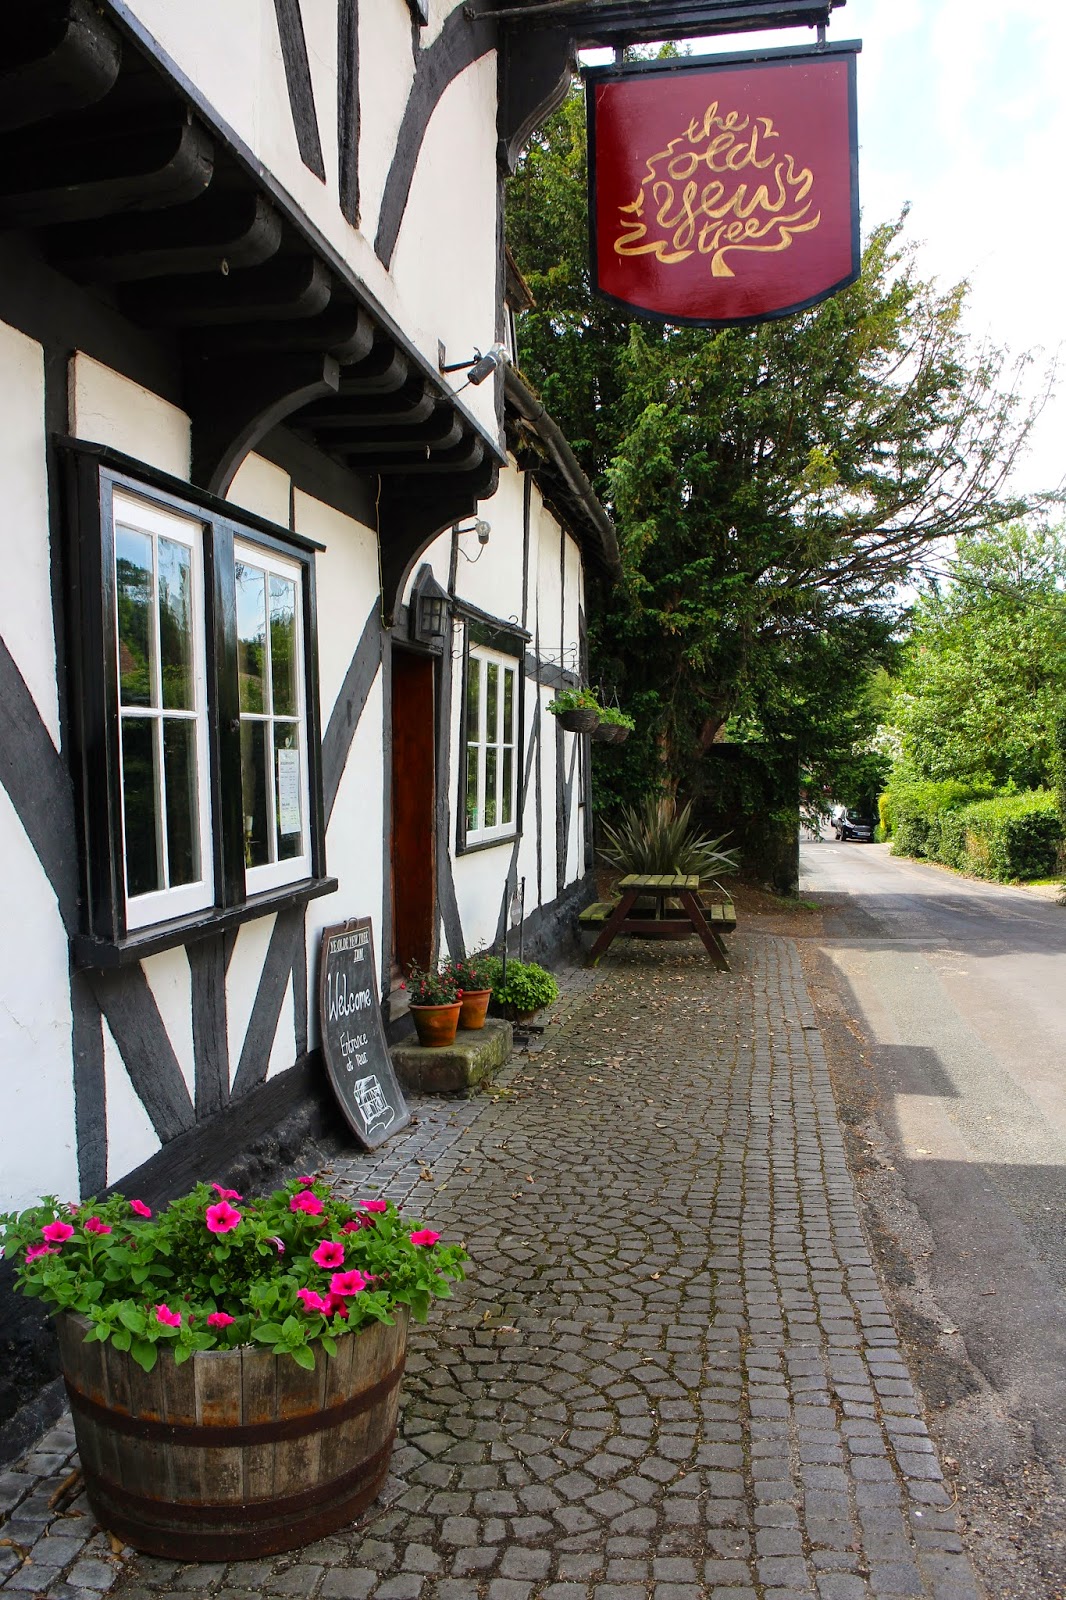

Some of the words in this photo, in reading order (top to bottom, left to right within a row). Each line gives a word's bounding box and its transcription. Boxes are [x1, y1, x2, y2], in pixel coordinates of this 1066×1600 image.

[682, 101, 749, 143] the
[668, 125, 775, 180] old
[698, 212, 790, 254] tree
[328, 972, 371, 1021] Welcome
[340, 1031, 368, 1056] Entrance
[346, 1056, 354, 1072] at
